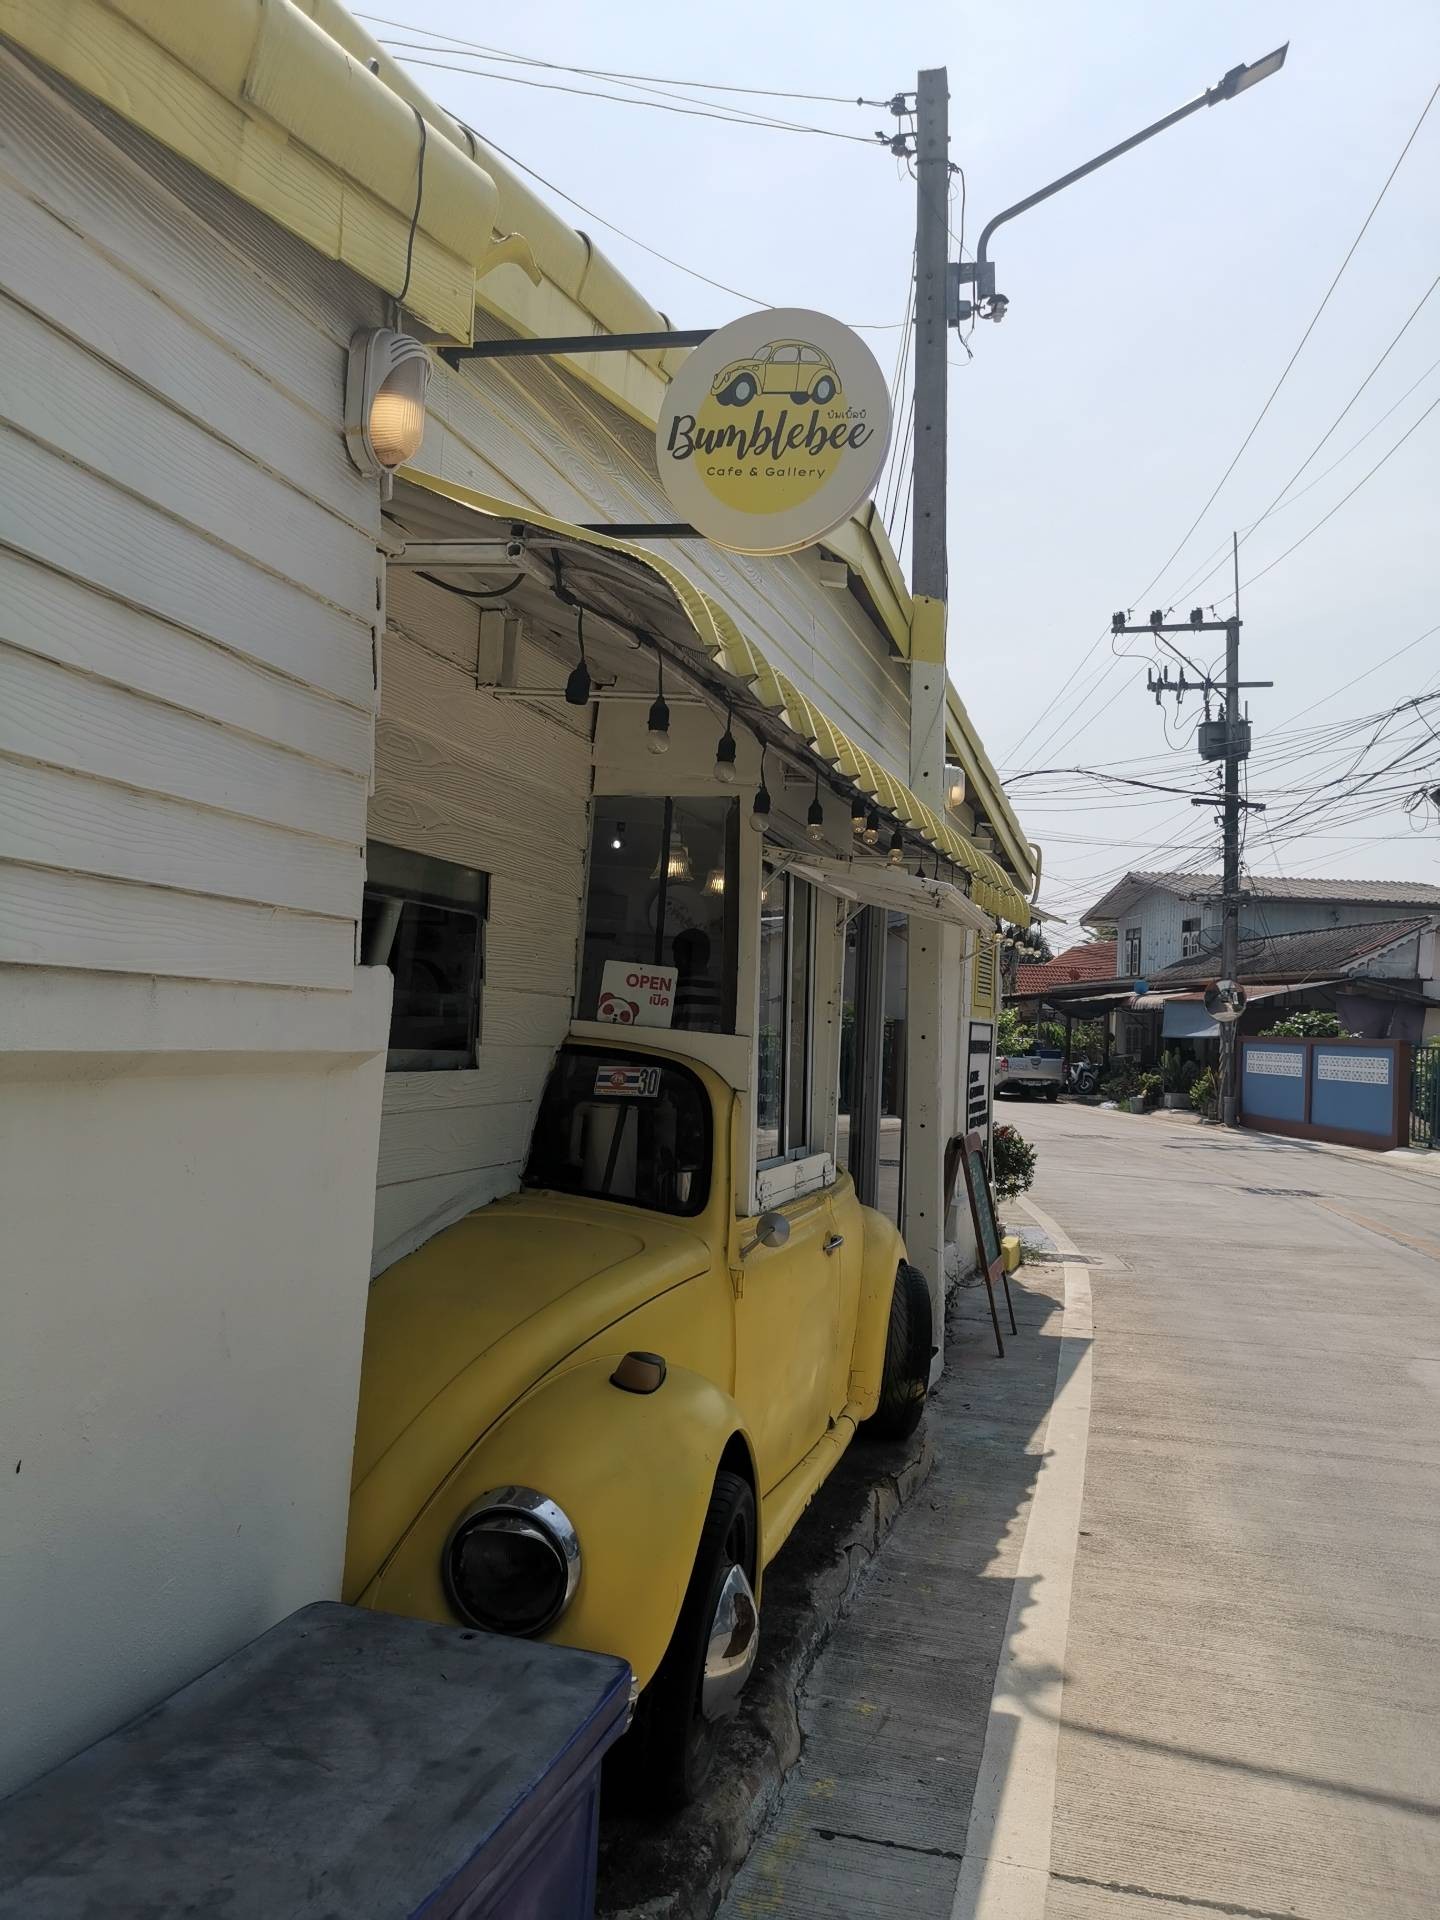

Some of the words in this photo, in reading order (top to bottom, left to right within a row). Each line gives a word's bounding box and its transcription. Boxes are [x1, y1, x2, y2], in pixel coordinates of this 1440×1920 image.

[667, 410, 874, 460] Bumblebee
[706, 467, 743, 477] Cafe
[749, 466, 758, 477] &
[765, 467, 826, 479] Gallery
[626, 974, 672, 991] OPEN
[638, 1069, 657, 1095] 30
